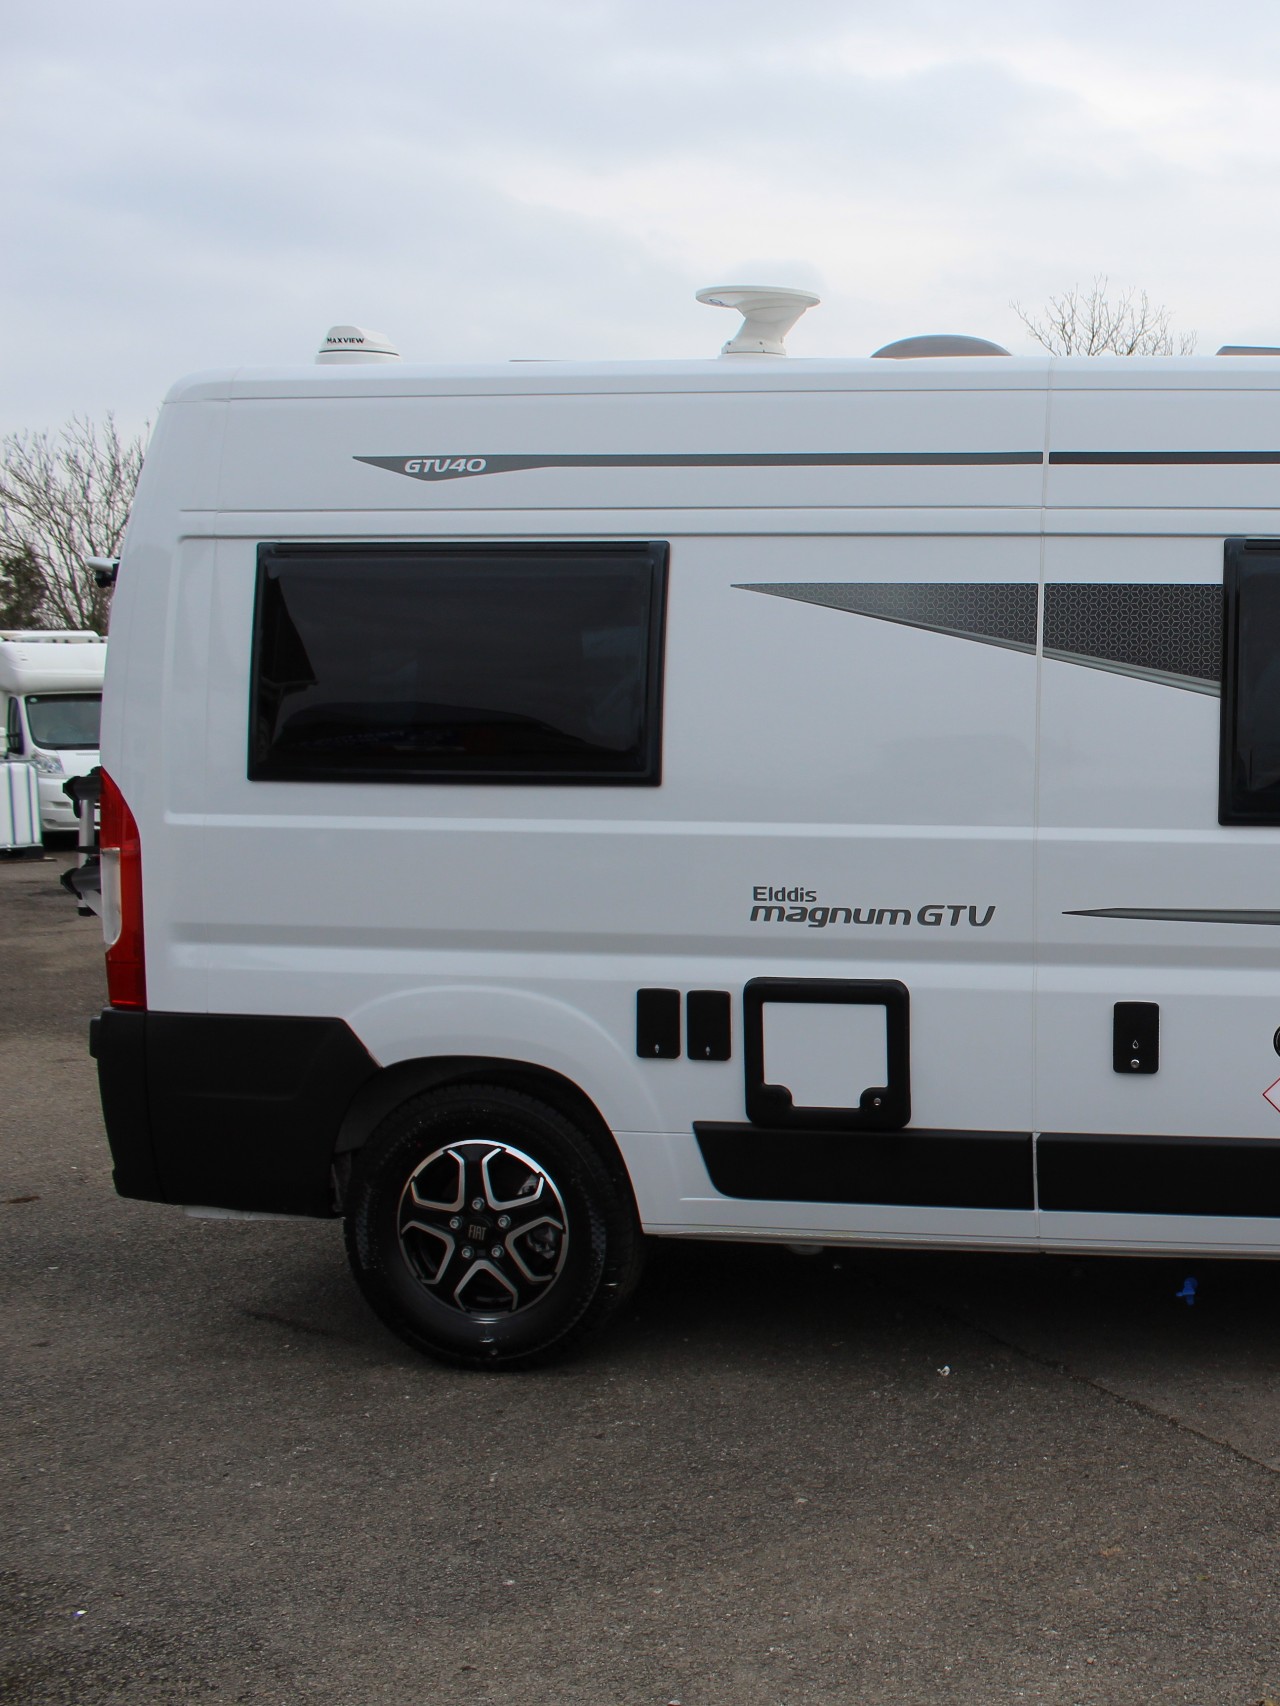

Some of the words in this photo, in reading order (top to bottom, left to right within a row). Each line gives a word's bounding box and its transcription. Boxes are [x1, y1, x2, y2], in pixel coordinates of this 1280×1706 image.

[753, 886, 817, 902] Elddis
[750, 905, 911, 928] magnum
[468, 1225, 486, 1240] FIAT
